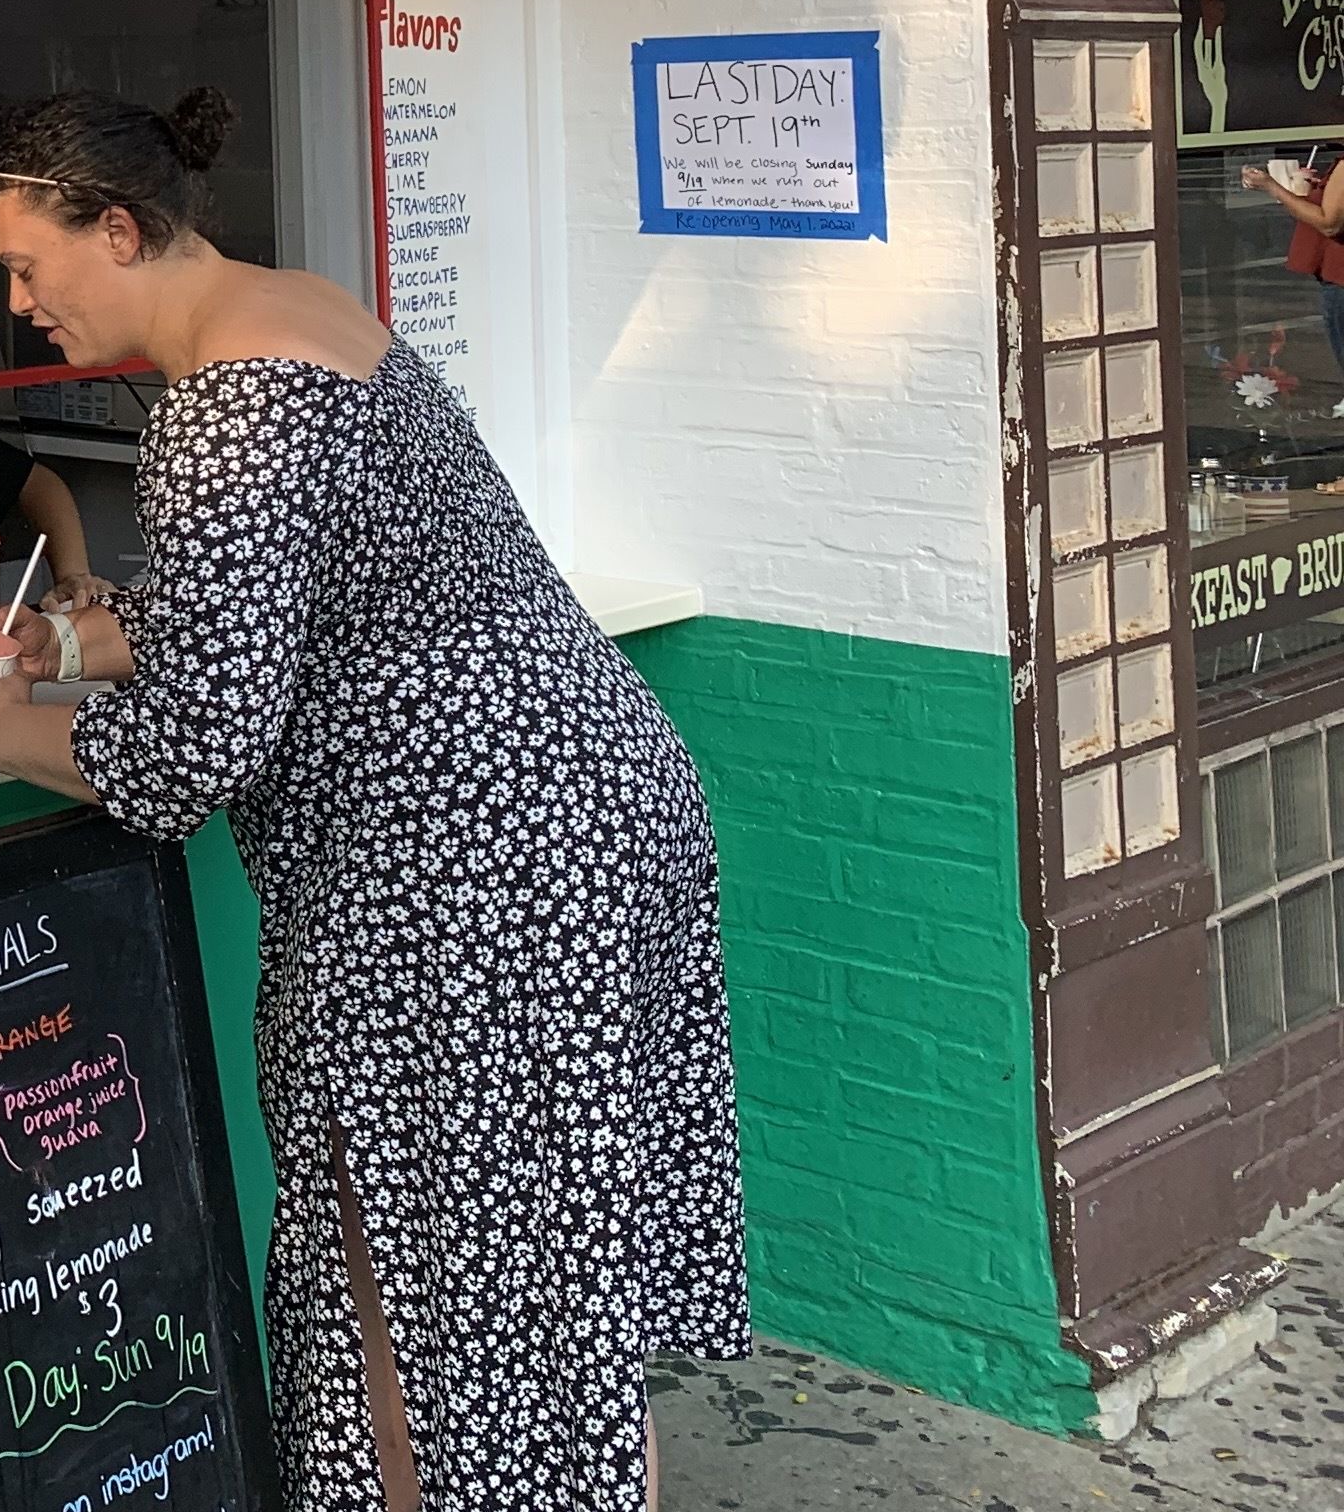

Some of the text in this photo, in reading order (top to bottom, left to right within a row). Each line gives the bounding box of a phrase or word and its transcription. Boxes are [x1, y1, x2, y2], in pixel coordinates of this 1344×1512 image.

[384, 125, 438, 147] BANANA
[772, 115, 821, 147] 19th
[663, 157, 853, 176] We will be closing Sunday
[387, 172, 425, 192] LIME
[711, 174, 744, 186] when
[751, 177, 767, 186] we
[776, 177, 803, 188] run
[814, 179, 839, 189] out
[386, 193, 466, 220] STRAWBERRY
[687, 195, 702, 207] of
[791, 197, 825, 208] thank
[828, 200, 854, 212] you!
[676, 211, 761, 231] Re-opening
[769, 216, 801, 232] May
[388, 246, 439, 265] ORANGE
[389, 267, 459, 290] CHOCOLATE
[390, 290, 457, 313] PINEAPPLE
[3, 1053, 117, 1118] passionfruit
[23, 1078, 126, 1135] orange juice
[39, 1119, 102, 1161] guava
[26, 1148, 143, 1227] squeezed
[48, 1220, 153, 1299] lemonade
[94, 1338, 152, 1394] Sun
[155, 1314, 211, 1382] 9/19
[100, 1414, 215, 1505] instagram!
